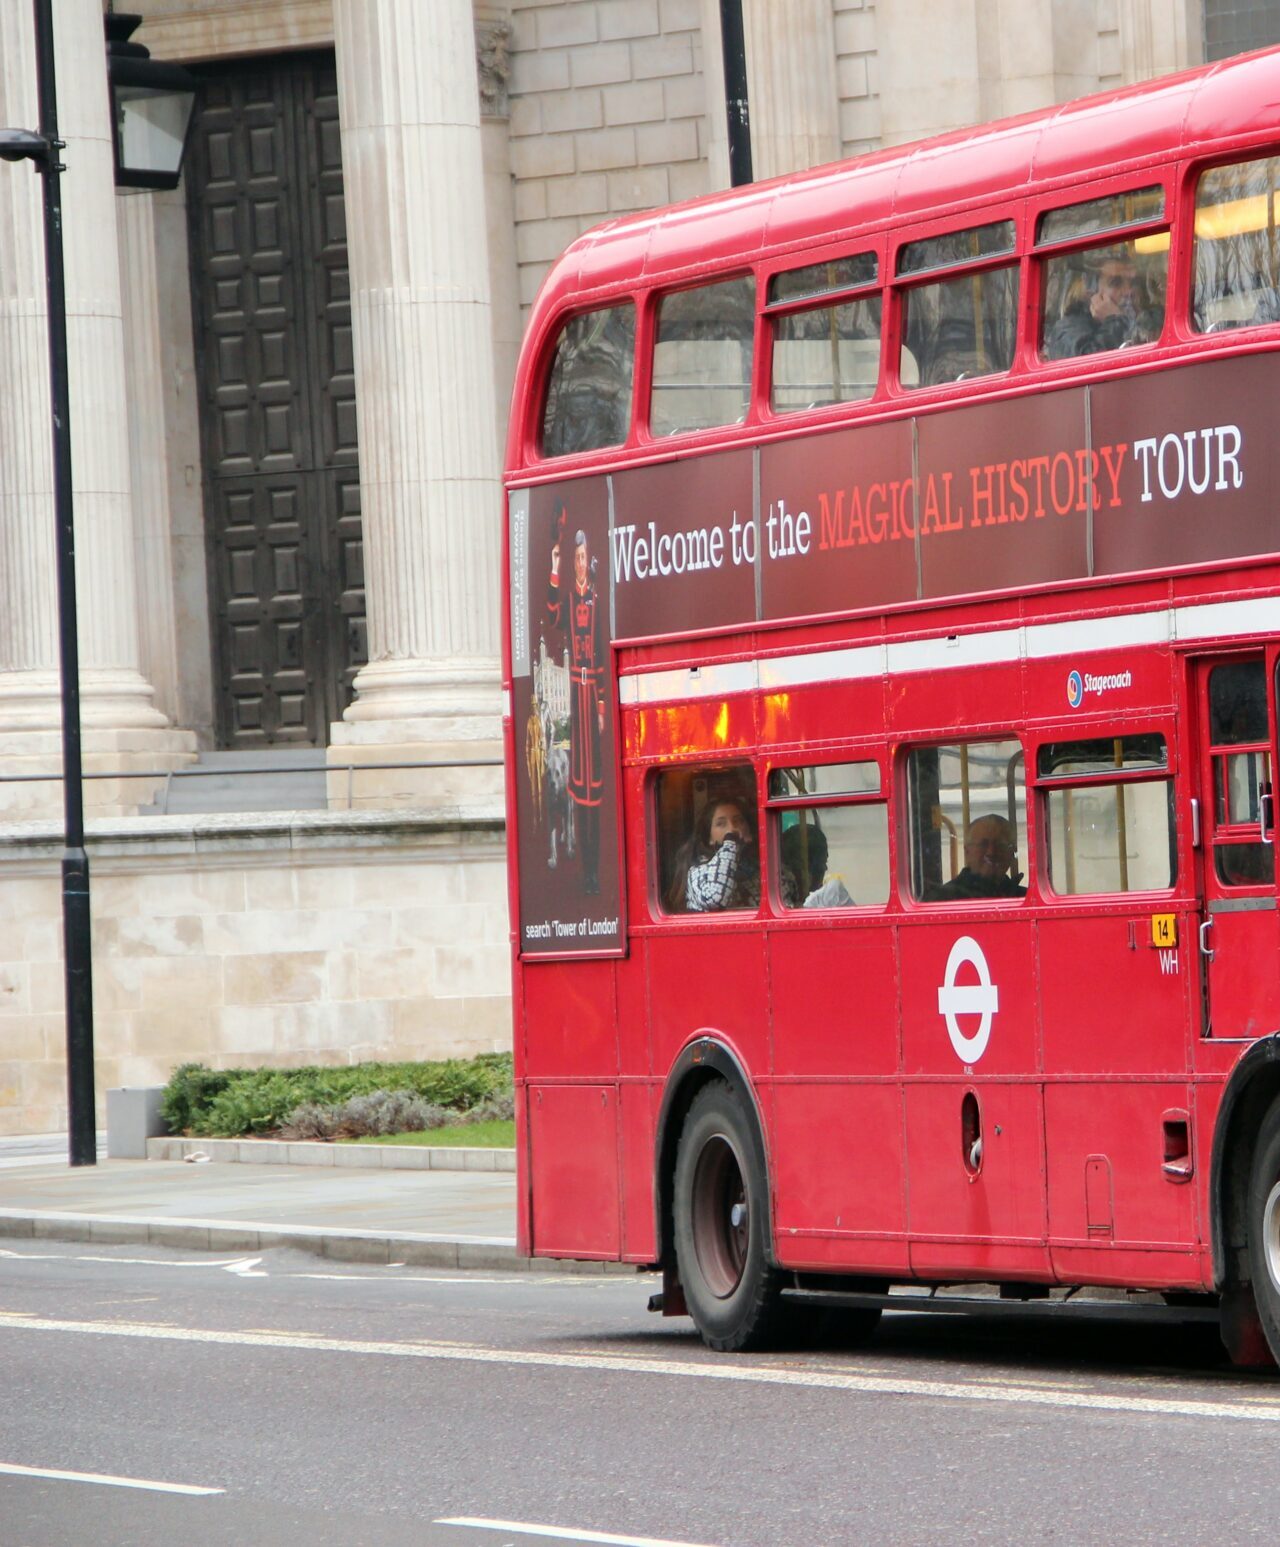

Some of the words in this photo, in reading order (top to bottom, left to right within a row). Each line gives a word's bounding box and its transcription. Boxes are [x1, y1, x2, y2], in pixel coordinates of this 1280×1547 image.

[608, 521, 724, 583] Welcome
[729, 510, 758, 566] to
[766, 500, 811, 559] the
[818, 472, 963, 551] MAGICAL
[969, 443, 1128, 528] HISTORY
[1134, 424, 1243, 502] TOUR
[514, 571, 520, 588] of
[1084, 670, 1132, 696] Stagecoach
[525, 920, 551, 938] search
[551, 920, 576, 937] 'Tower
[578, 918, 587, 936] of
[588, 917, 618, 935] London'
[1157, 920, 1169, 940] 14
[1159, 949, 1179, 975] WH
